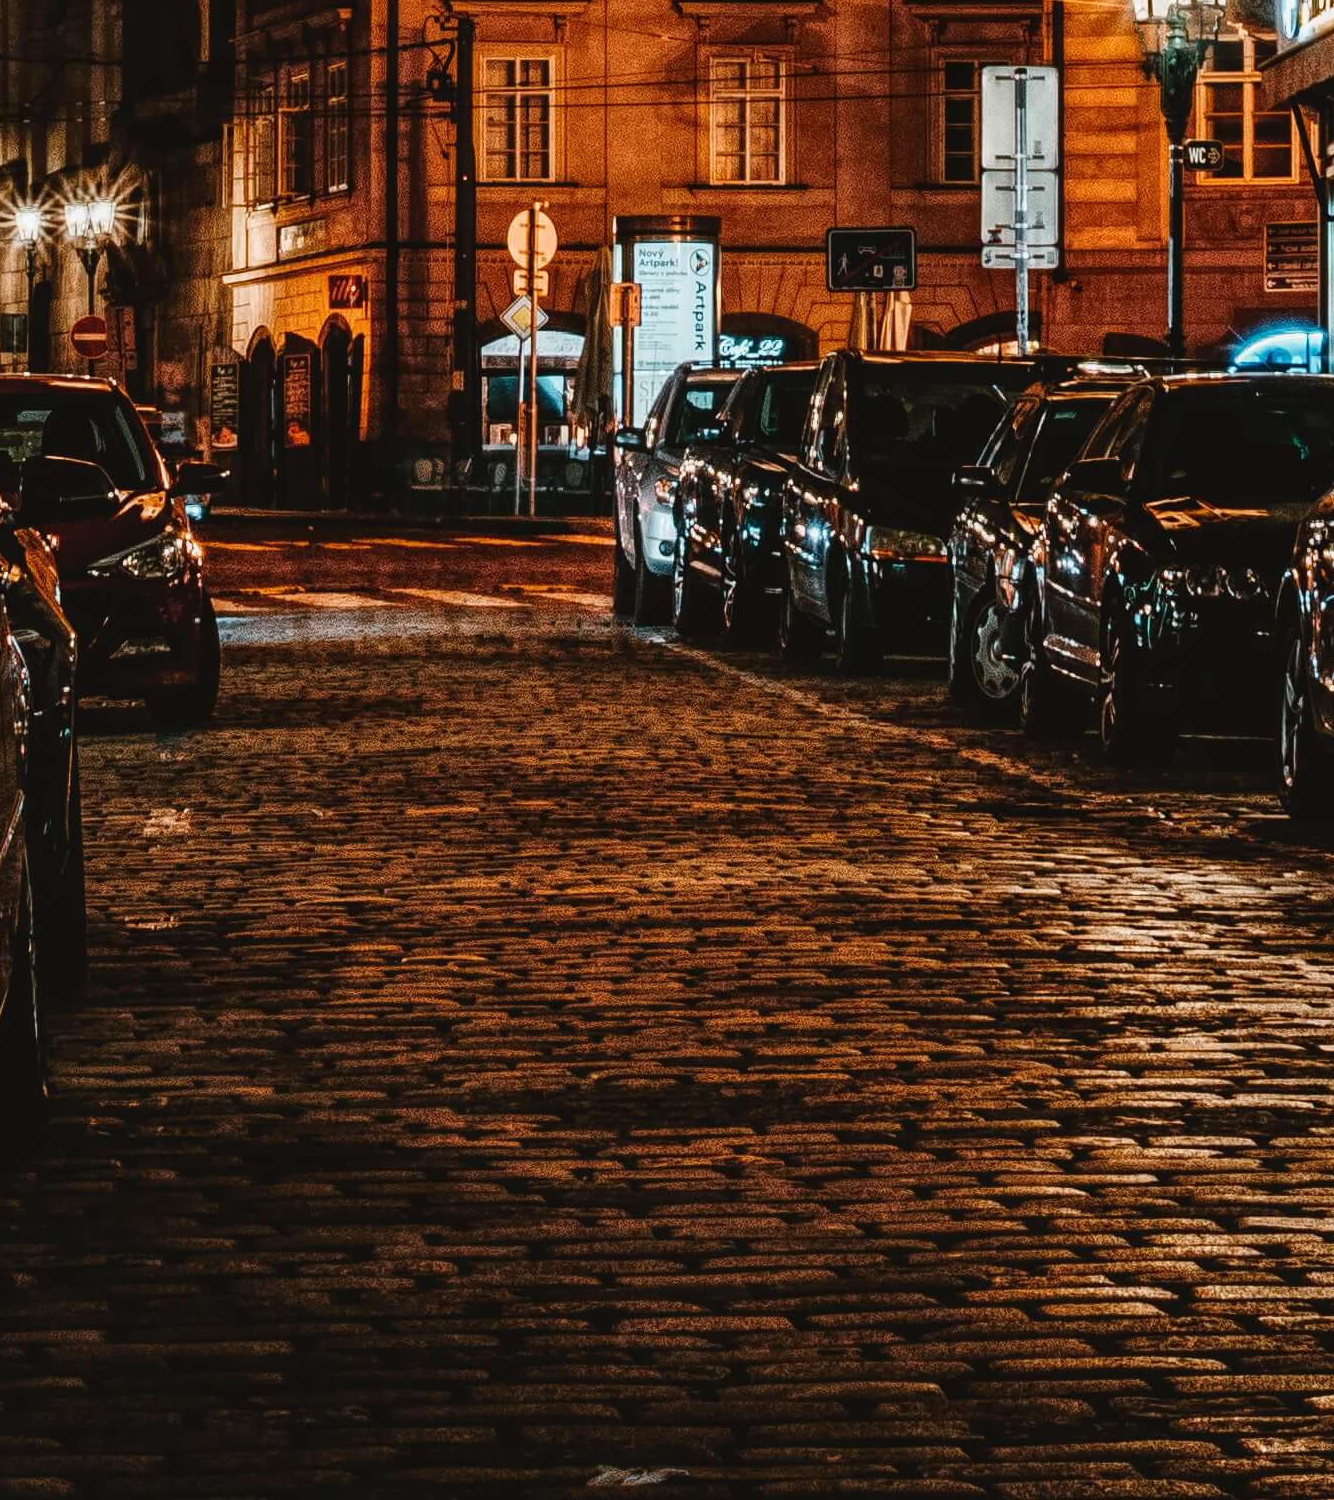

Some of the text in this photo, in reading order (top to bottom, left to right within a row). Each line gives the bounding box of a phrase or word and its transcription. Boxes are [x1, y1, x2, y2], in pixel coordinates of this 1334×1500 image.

[1188, 146, 1207, 165] WC
[638, 258, 679, 269] Artpark!
[692, 280, 707, 351] Artpark
